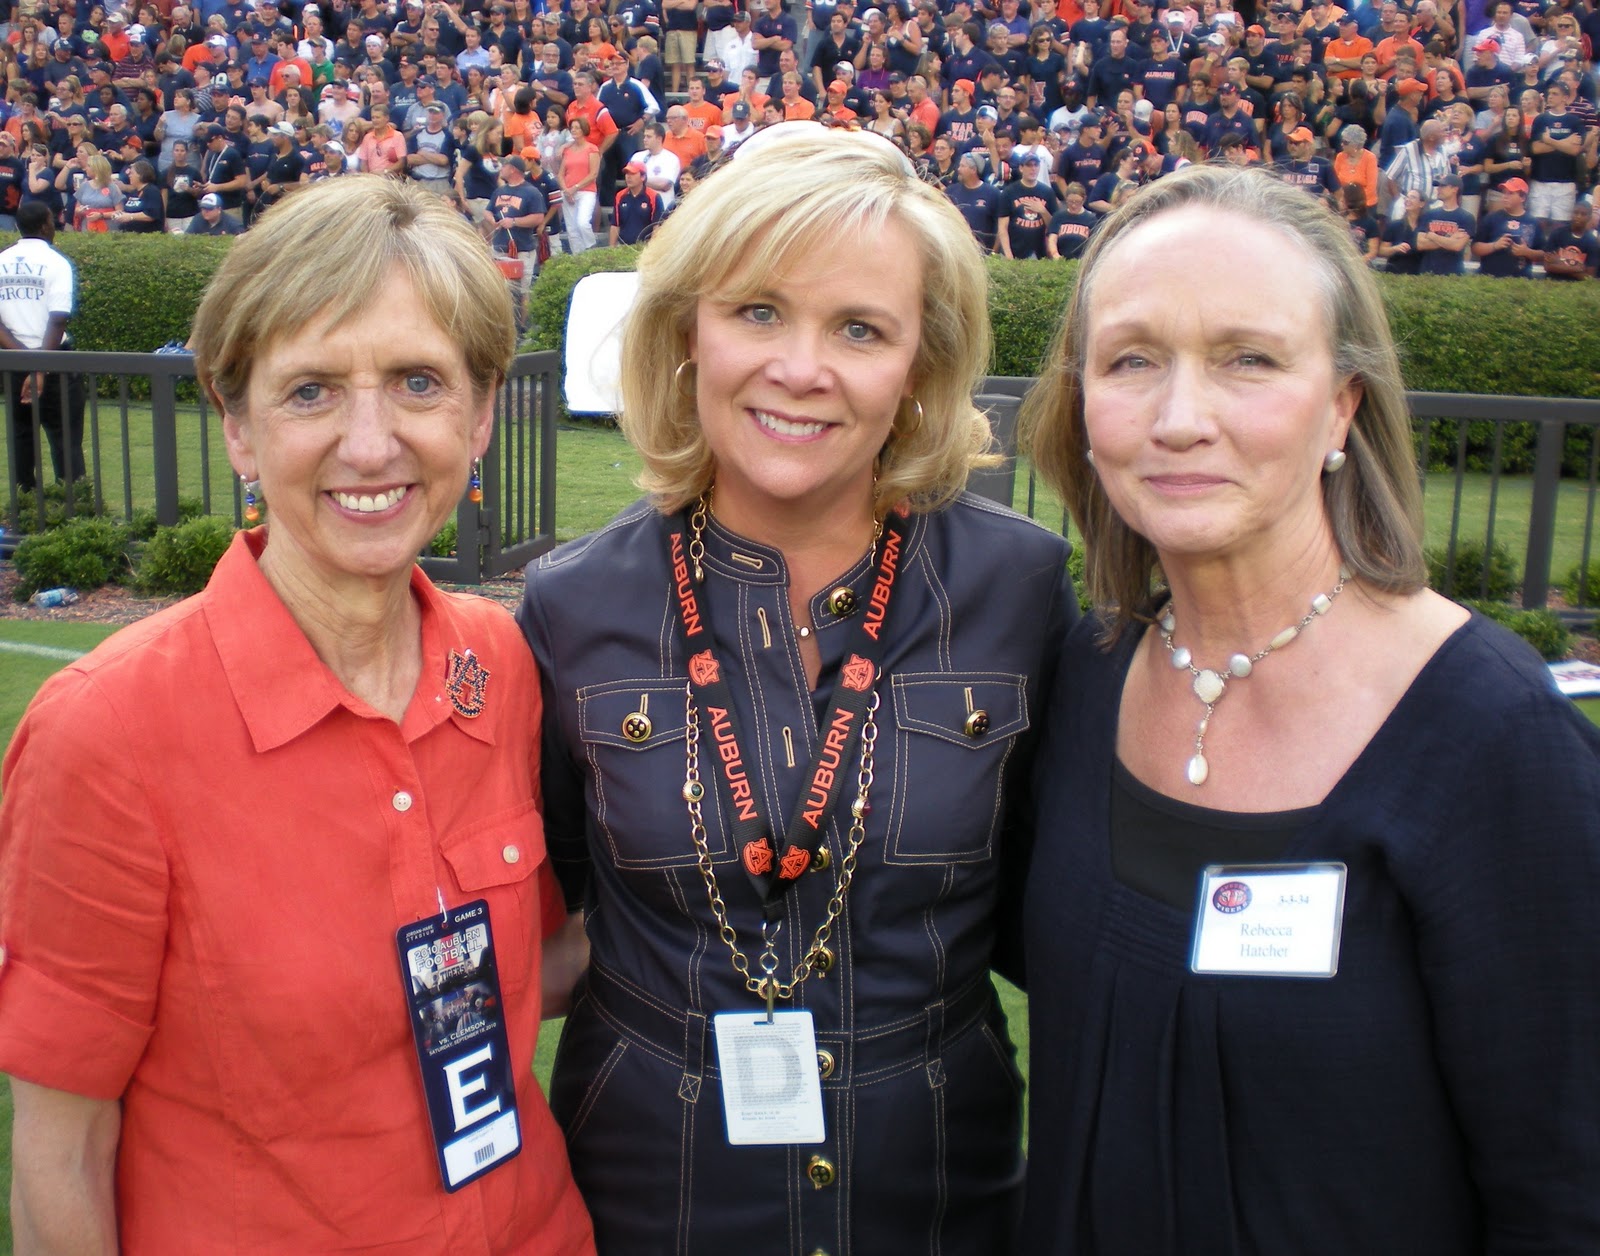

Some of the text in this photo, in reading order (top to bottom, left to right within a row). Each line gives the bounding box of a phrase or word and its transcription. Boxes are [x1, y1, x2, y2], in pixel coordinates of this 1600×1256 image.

[670, 532, 703, 636] AUBURN
[863, 530, 902, 640] AUBURN
[708, 706, 758, 821] AUBURN
[803, 708, 854, 828] AUBURN
[454, 907, 483, 923] GAME 3
[406, 924, 434, 938] JORDAN-HARE
[406, 930, 435, 943] STADIUM
[1240, 923, 1293, 937] Rebecca
[413, 928, 481, 960] 2010 AUBURN
[415, 940, 483, 973] FOOTBALL
[1240, 943, 1289, 958] Hatcher
[450, 1020, 486, 1041] CLEMSON
[454, 1031, 479, 1045] SEPTEMBER
[443, 1043, 501, 1132] E
